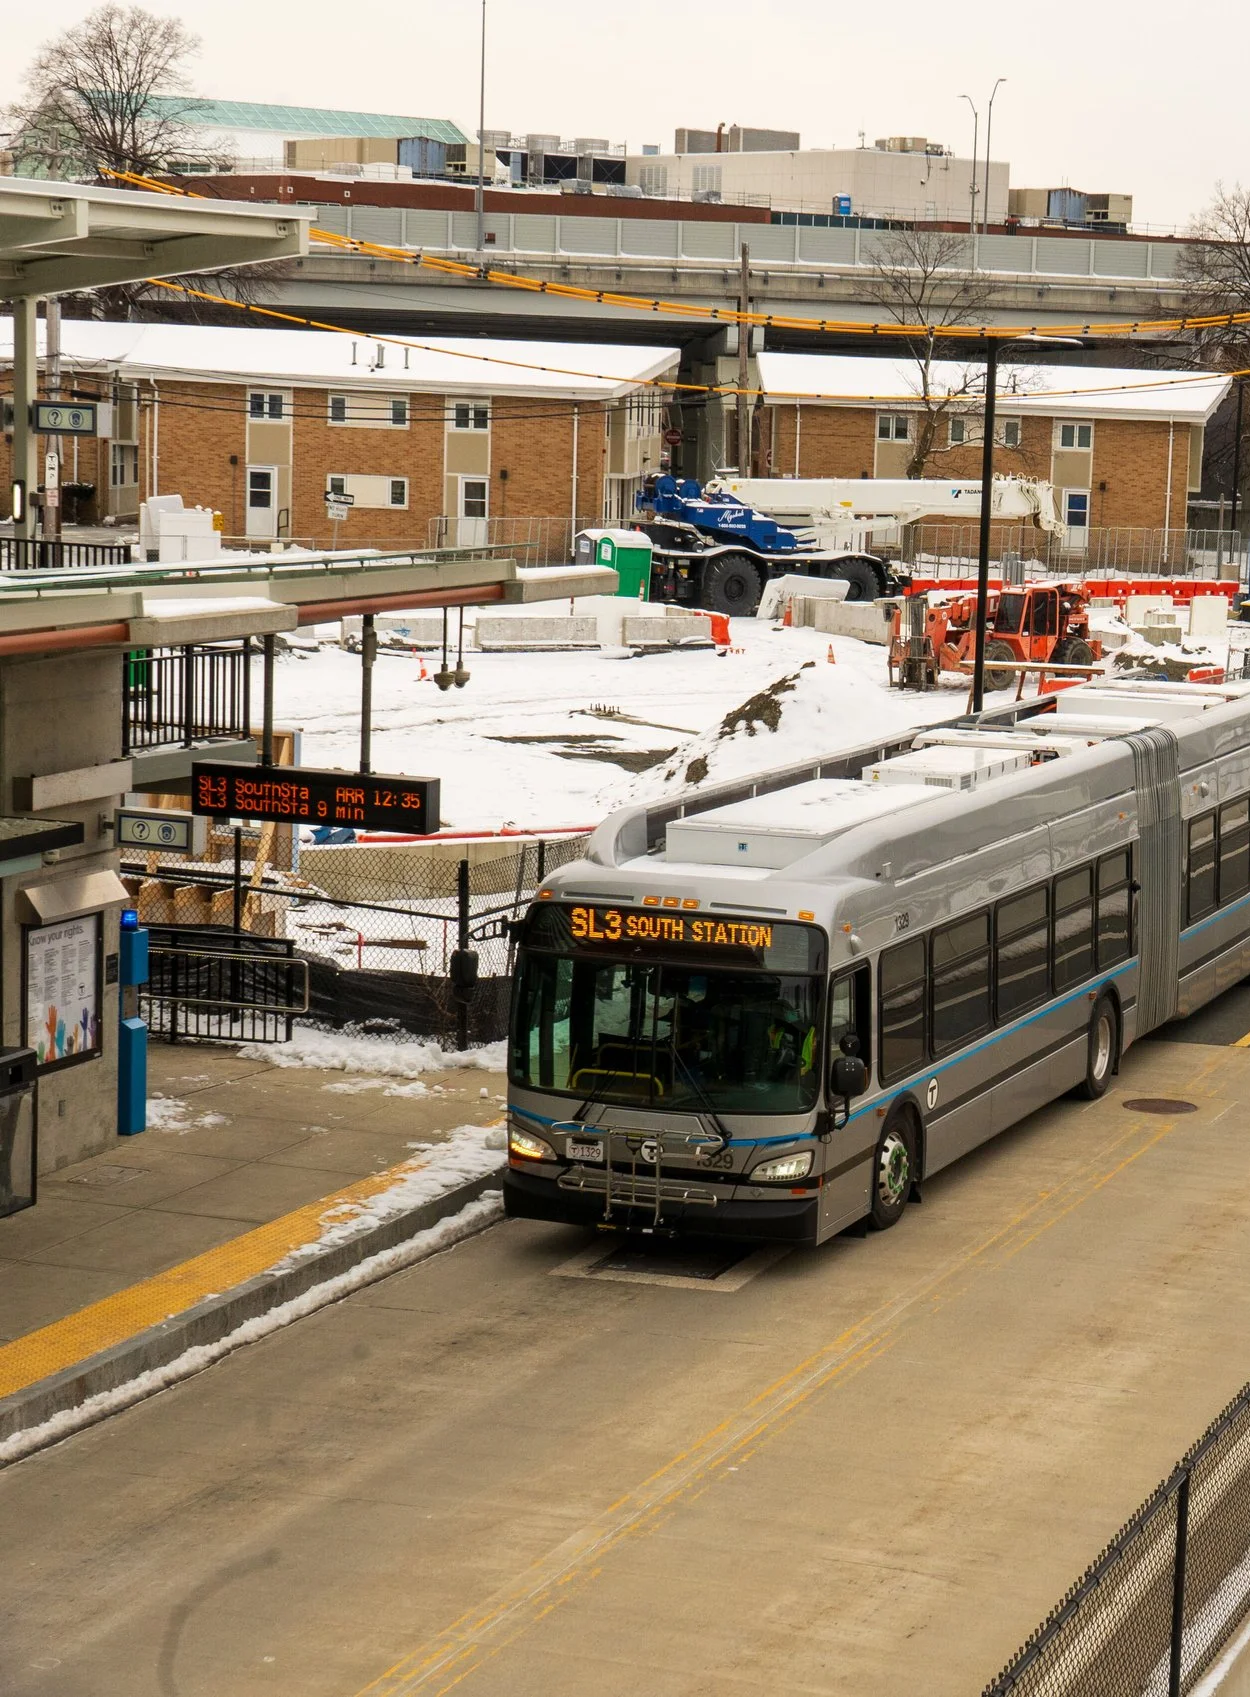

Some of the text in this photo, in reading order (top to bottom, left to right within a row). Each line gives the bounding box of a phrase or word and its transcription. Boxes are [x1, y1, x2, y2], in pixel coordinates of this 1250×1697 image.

[199, 776, 421, 809] SL3 SouthSta ARR 12:35
[199, 792, 365, 820] SL3 SouthSta 9 min
[571, 907, 772, 948] SL3 SOUTH STATION
[895, 912, 910, 931] 1329
[28, 934, 47, 947] Know
[47, 930, 63, 945] your
[929, 1084, 937, 1105] T
[580, 1146, 601, 1158] 1329
